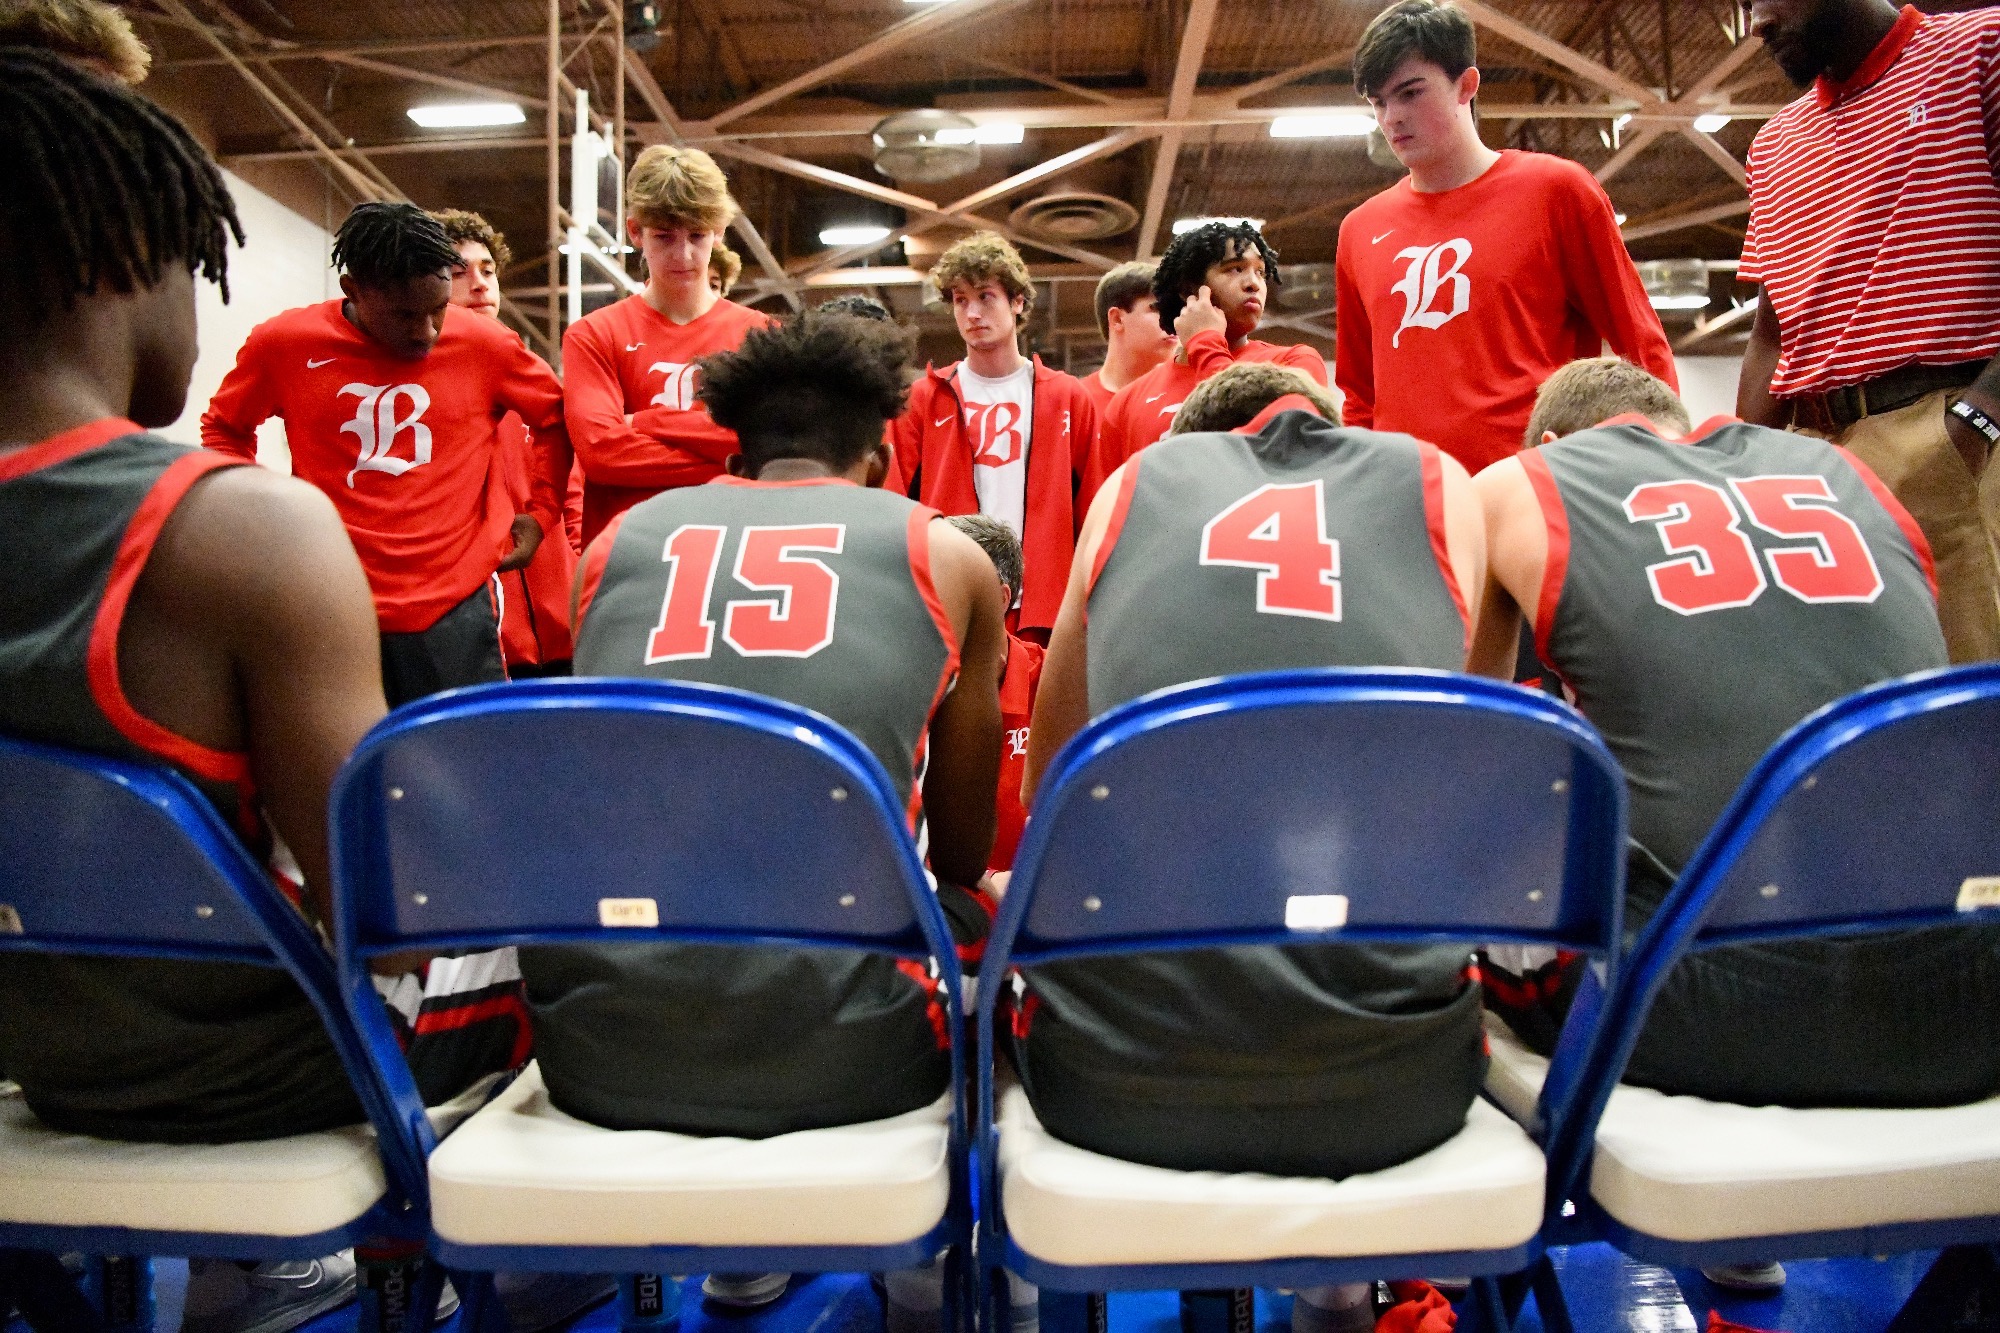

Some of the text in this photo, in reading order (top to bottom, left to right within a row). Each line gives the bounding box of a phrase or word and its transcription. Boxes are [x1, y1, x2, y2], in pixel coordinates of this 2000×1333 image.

[1390, 237, 1473, 349] B
[336, 382, 433, 490] B
[644, 523, 847, 666] 15
[1199, 479, 1342, 623] 4
[1621, 474, 1885, 617] 35
